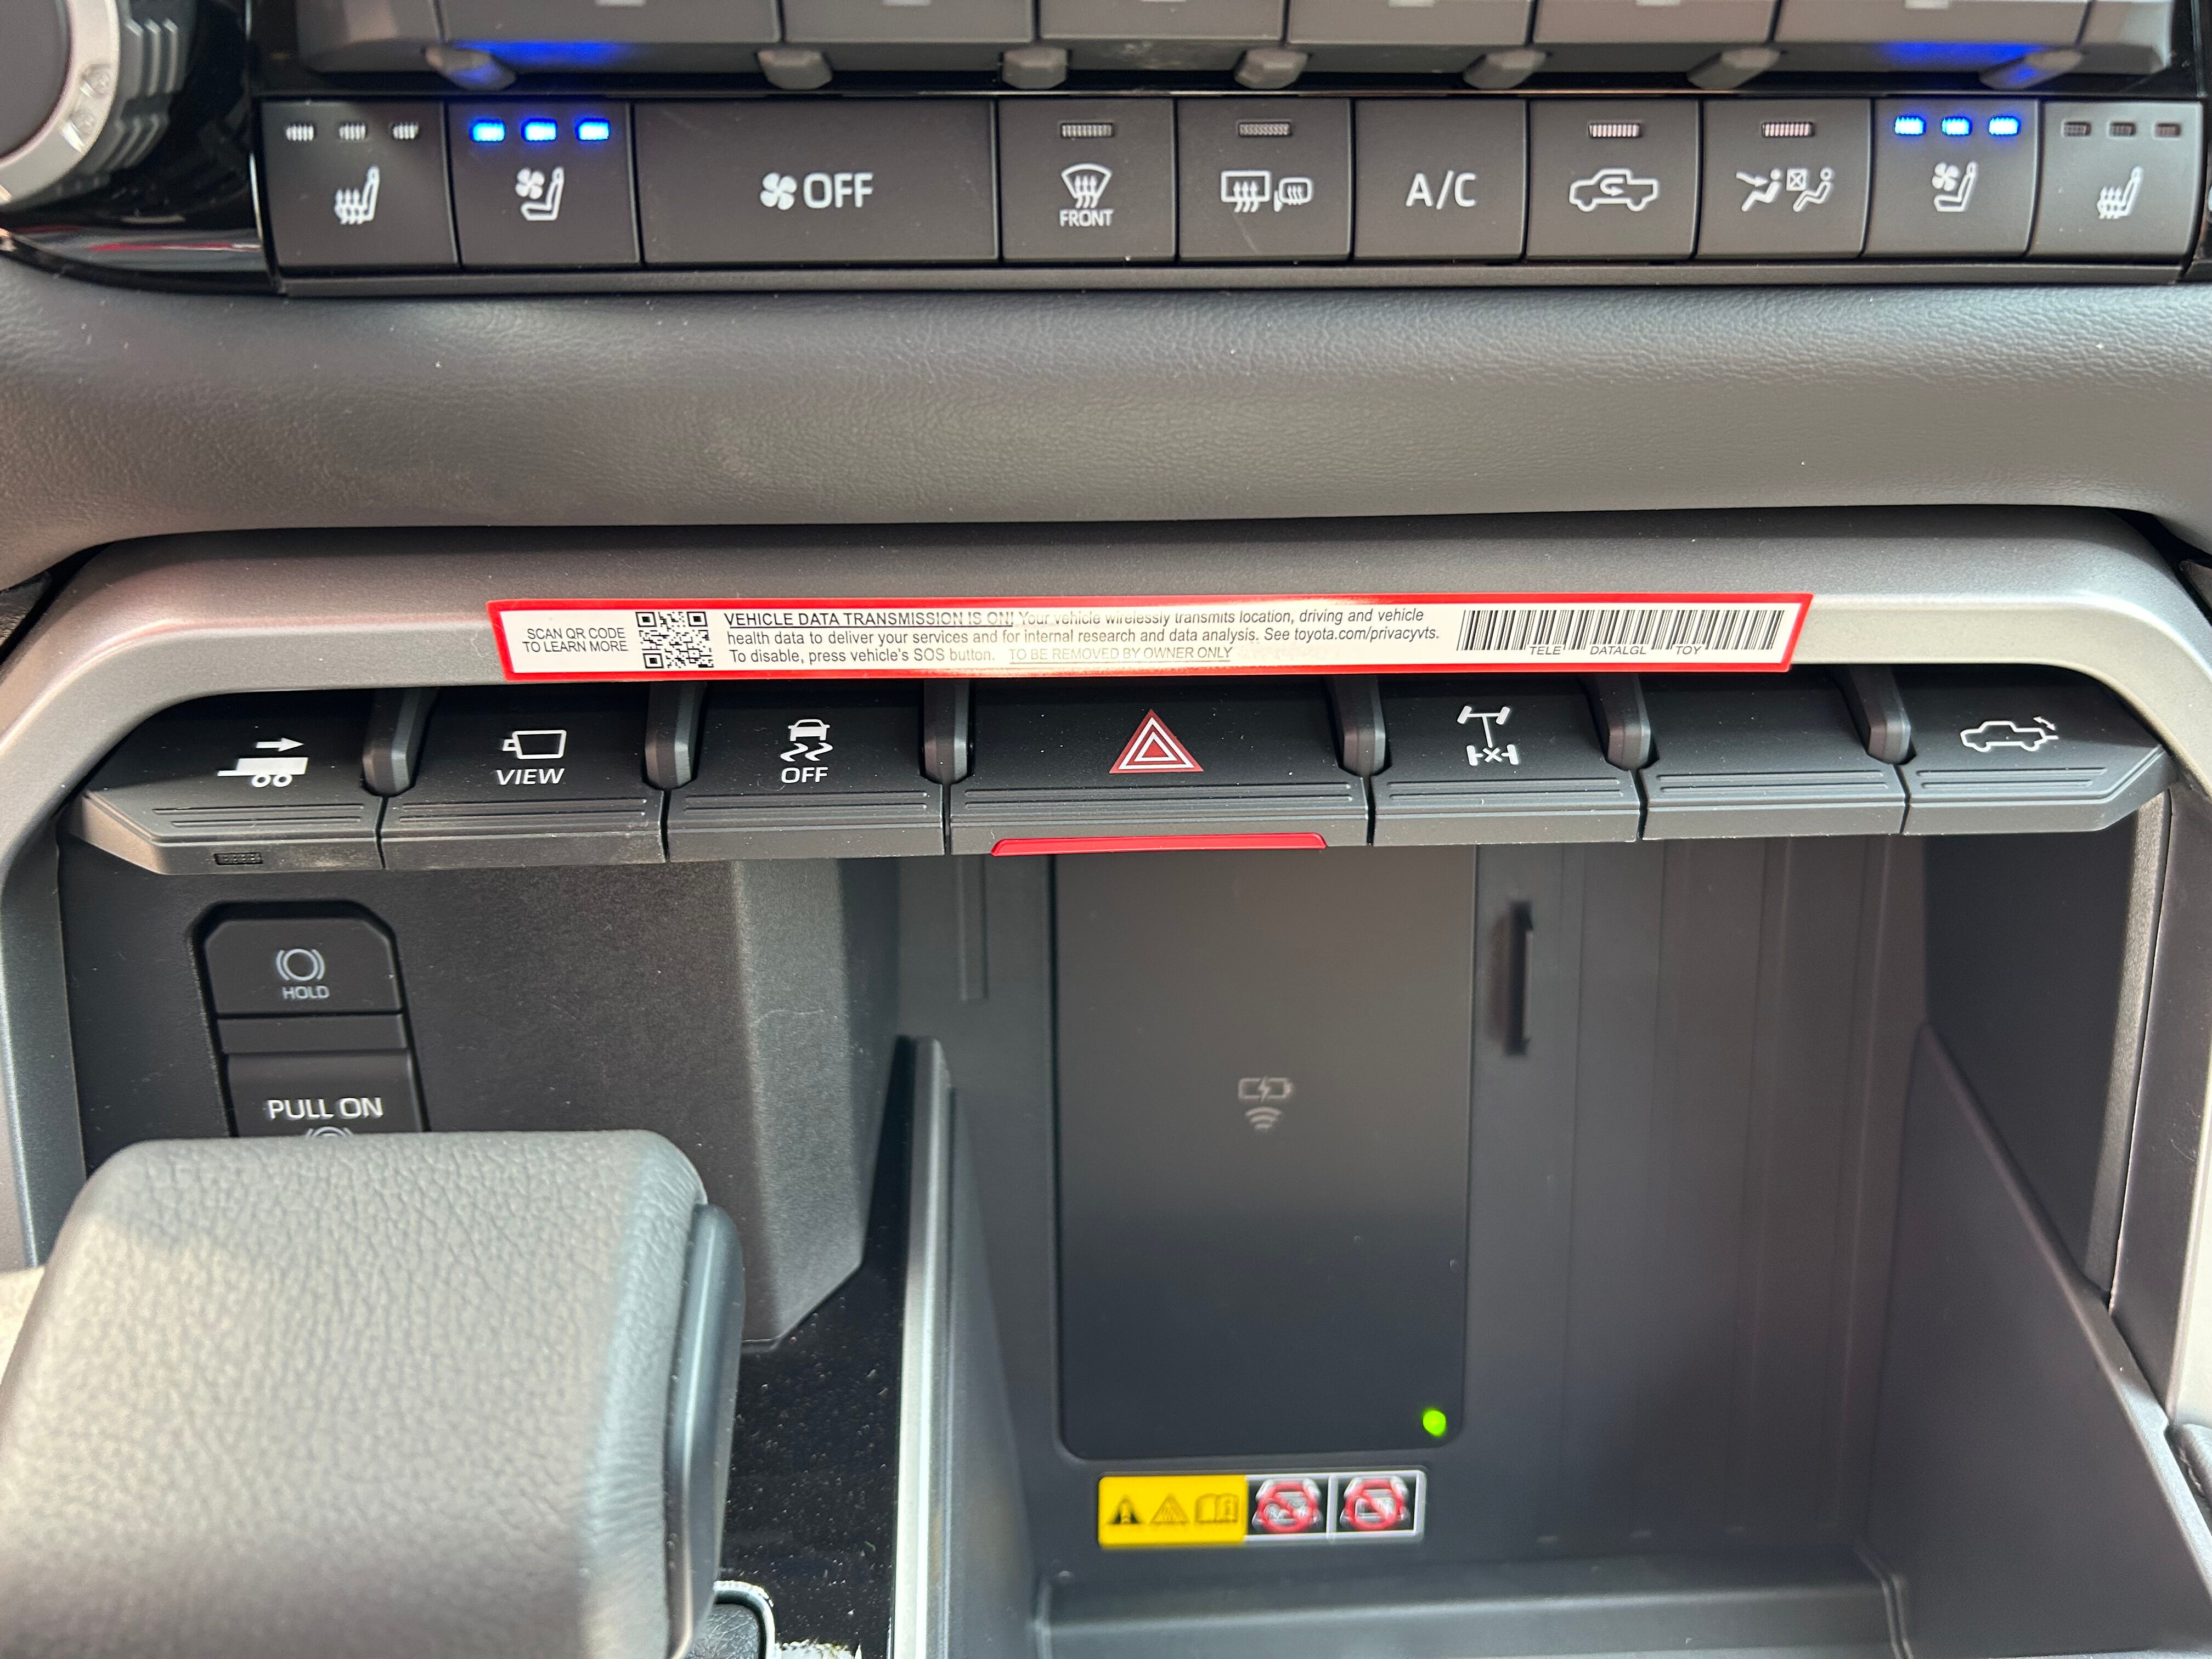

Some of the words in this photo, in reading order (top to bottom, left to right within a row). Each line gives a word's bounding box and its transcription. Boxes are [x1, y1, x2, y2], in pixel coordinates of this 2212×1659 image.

[803, 172, 873, 209] OFF
[1405, 170, 1476, 210] A/C
[1059, 209, 1113, 227] FRONT
[724, 613, 793, 625] VEHICLE
[799, 613, 840, 625] DATA
[843, 612, 963, 625] TRANSMISSION
[968, 612, 981, 624] IS
[988, 612, 1013, 624] ON!
[1019, 612, 1049, 624] Your
[1054, 611, 1100, 624] vehicle
[1105, 611, 1170, 627] wirelessly
[1175, 611, 1235, 623] transmits
[1240, 610, 1294, 624] location,
[1300, 610, 1343, 625] driving
[1348, 608, 1373, 622] and
[1378, 608, 1424, 621] vehicle
[527, 629, 562, 640] SCAN
[566, 628, 586, 639] QR
[589, 628, 626, 639] CODE
[727, 631, 769, 644] health
[775, 631, 804, 644] data
[810, 631, 822, 644] to
[828, 631, 873, 644] deliver
[878, 633, 908, 646] your
[913, 630, 968, 643] services
[973, 630, 997, 643] and
[1002, 630, 1020, 643] for
[1025, 629, 1073, 642] internal
[1079, 629, 1135, 642] research
[1140, 629, 1165, 641] and
[1170, 628, 1197, 641] data
[1203, 628, 1259, 644] analysis.
[1265, 628, 1289, 640] See
[1295, 627, 1439, 643] toyota.com/privacyvts.
[522, 641, 540, 652] TO
[544, 641, 586, 652] LEARN
[590, 641, 628, 652] MORE
[1530, 646, 1561, 655] TELE
[1590, 646, 1646, 655] DATALGL
[1675, 646, 1702, 655] TOY
[729, 650, 746, 662] To
[751, 649, 804, 664] disable,
[809, 652, 845, 664] press
[914, 648, 945, 661] SOS
[950, 648, 995, 661] button.
[1009, 648, 1026, 659] TO
[1031, 648, 1048, 659] BE
[1052, 648, 1119, 659] REMOVED
[1124, 647, 1141, 659] BY
[1144, 647, 1194, 658] OWNER
[1198, 647, 1233, 658] ONLY
[496, 768, 564, 785] VIEW
[780, 767, 828, 783] OFF
[282, 985, 330, 1000] HOLD
[267, 1098, 334, 1120] PULL
[339, 1097, 383, 1119] ON
